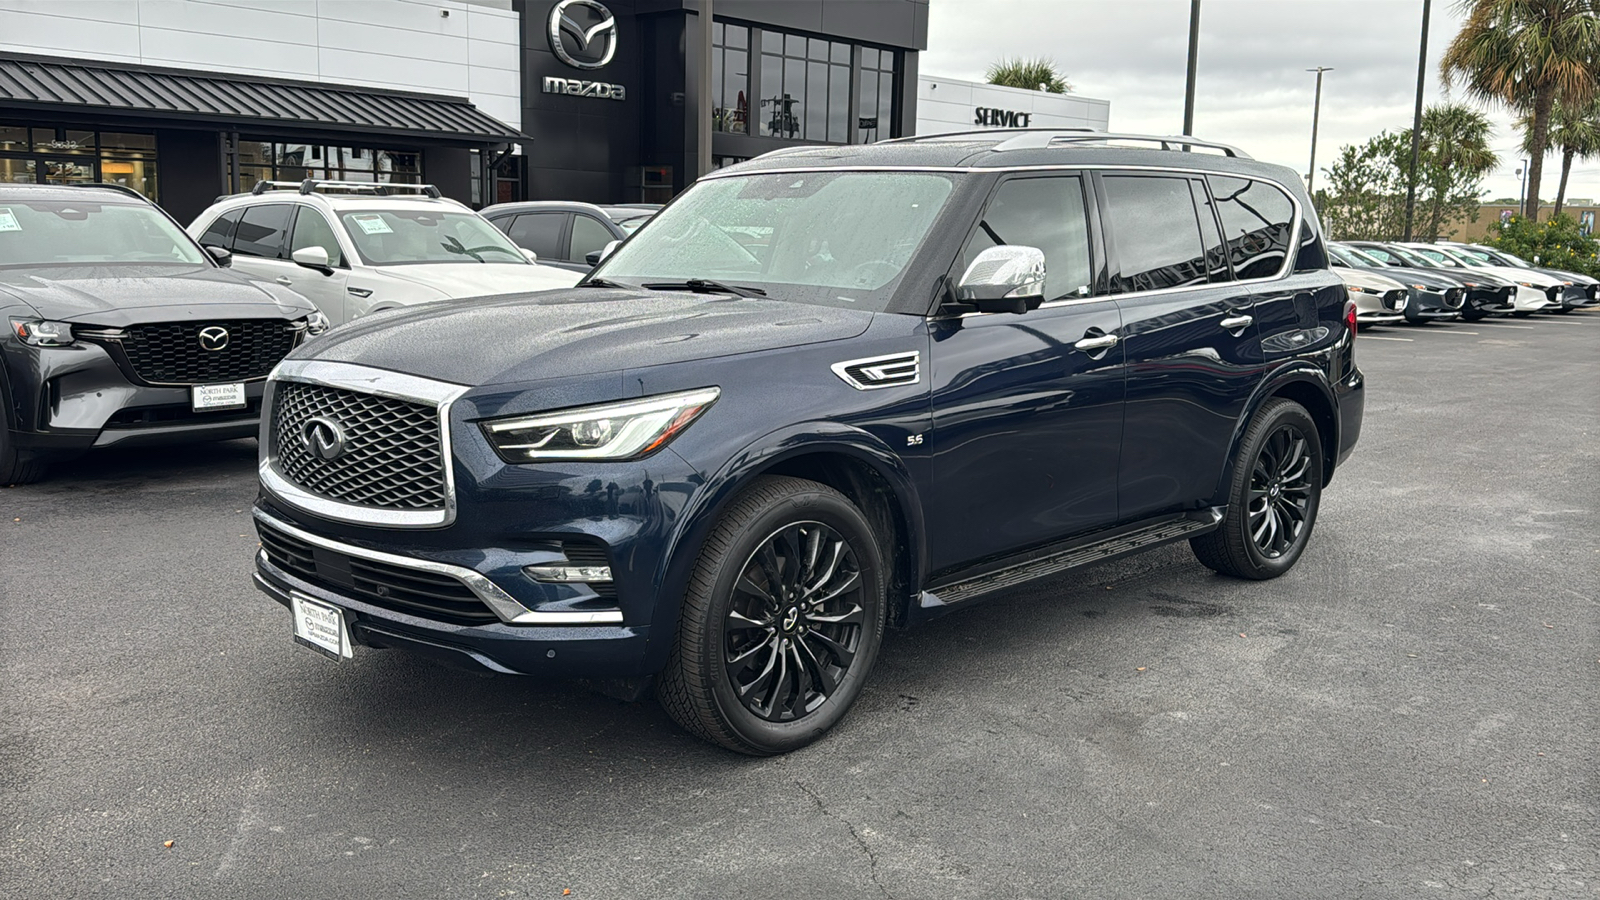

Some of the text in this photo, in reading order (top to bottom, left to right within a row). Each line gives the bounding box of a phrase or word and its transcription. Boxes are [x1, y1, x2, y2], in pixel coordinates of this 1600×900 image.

[974, 107, 1032, 128] SERVICE
[300, 605, 337, 626] NORTH PARK
